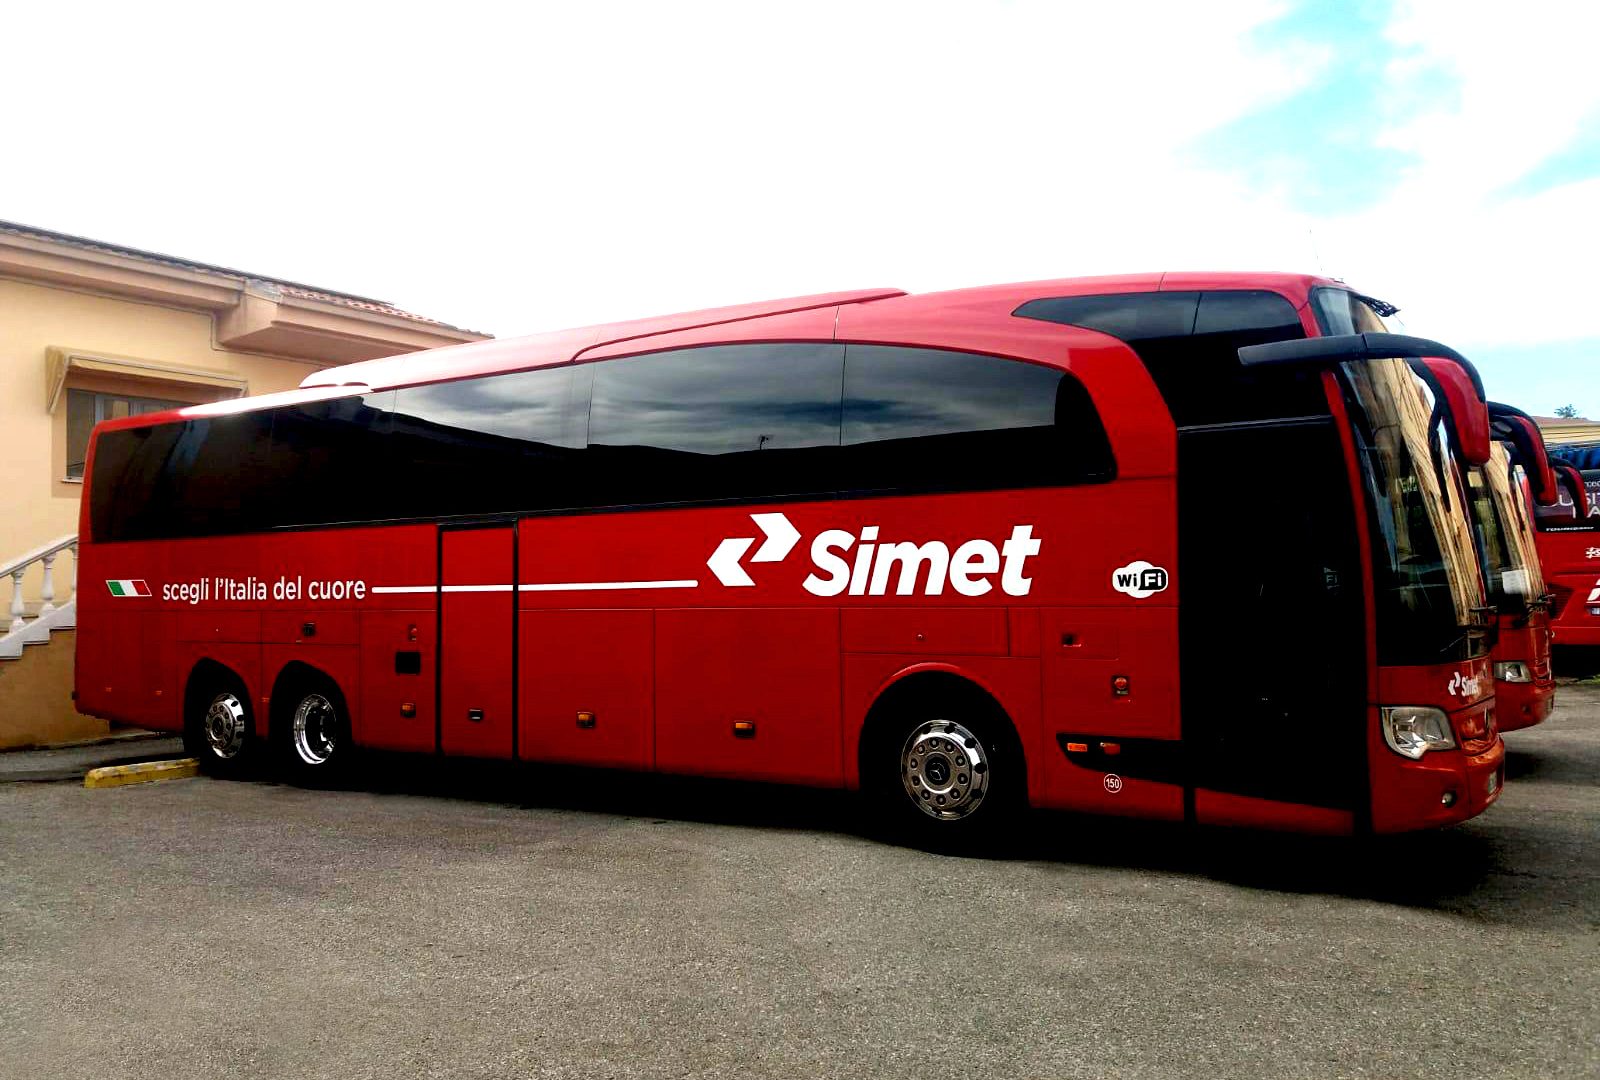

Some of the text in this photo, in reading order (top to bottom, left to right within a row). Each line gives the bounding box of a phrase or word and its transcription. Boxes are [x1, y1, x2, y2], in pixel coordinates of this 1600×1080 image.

[802, 525, 1042, 597] Simet
[162, 575, 366, 605] scegli l'Italia del cuore
[1106, 777, 1120, 789] 150
